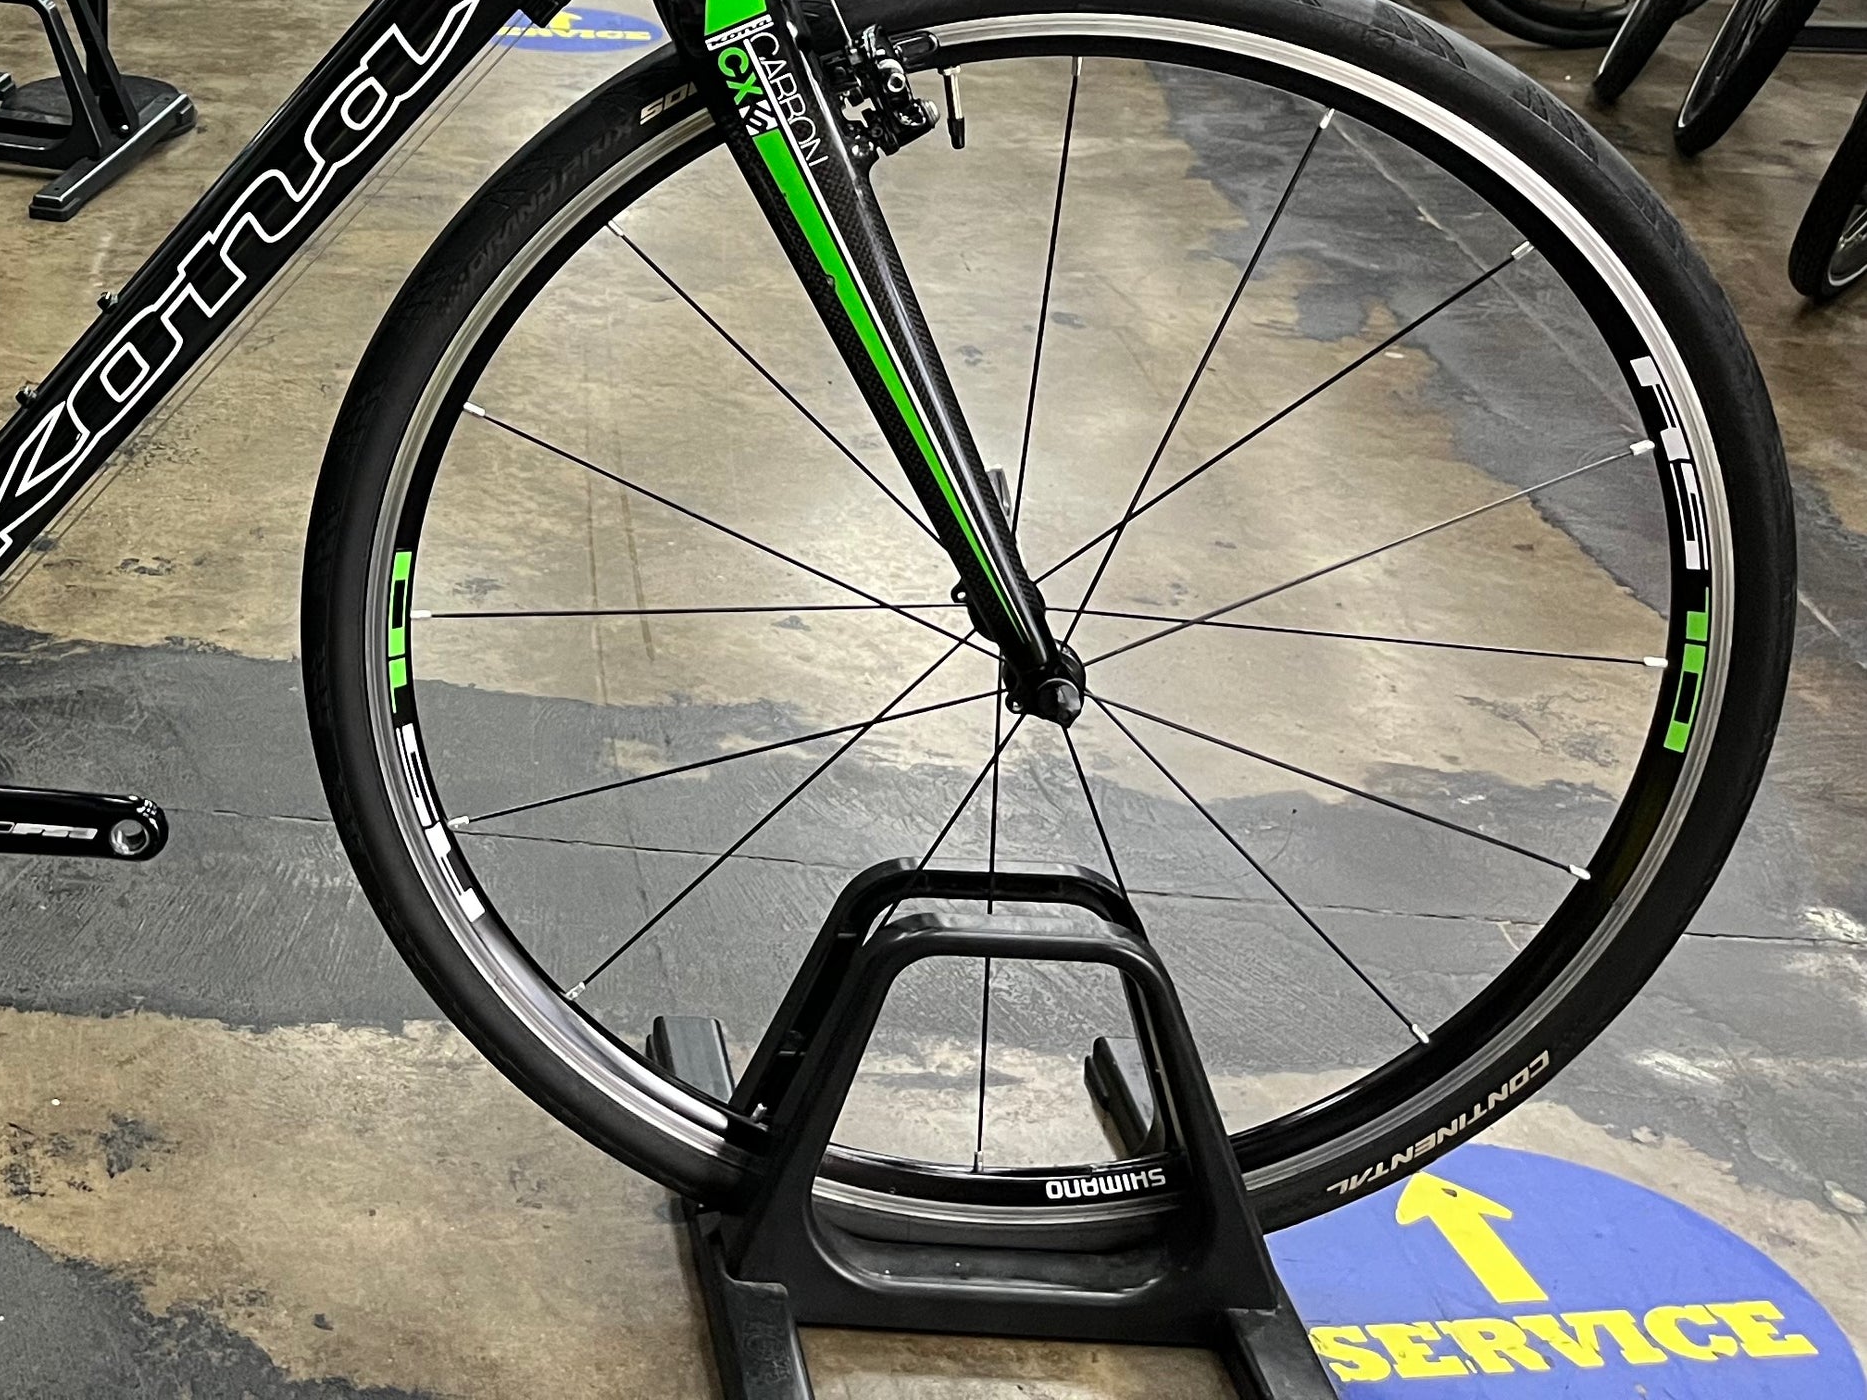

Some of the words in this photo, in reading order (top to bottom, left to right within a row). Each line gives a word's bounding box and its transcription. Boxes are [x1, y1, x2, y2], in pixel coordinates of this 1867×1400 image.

[717, 46, 764, 106] CX
[749, 31, 830, 168] CARBON
[1327, 1048, 1553, 1196] CONTINENTAL
[1045, 1166, 1167, 1200] SHIMANO
[1307, 1299, 1819, 1384] SERVICE
